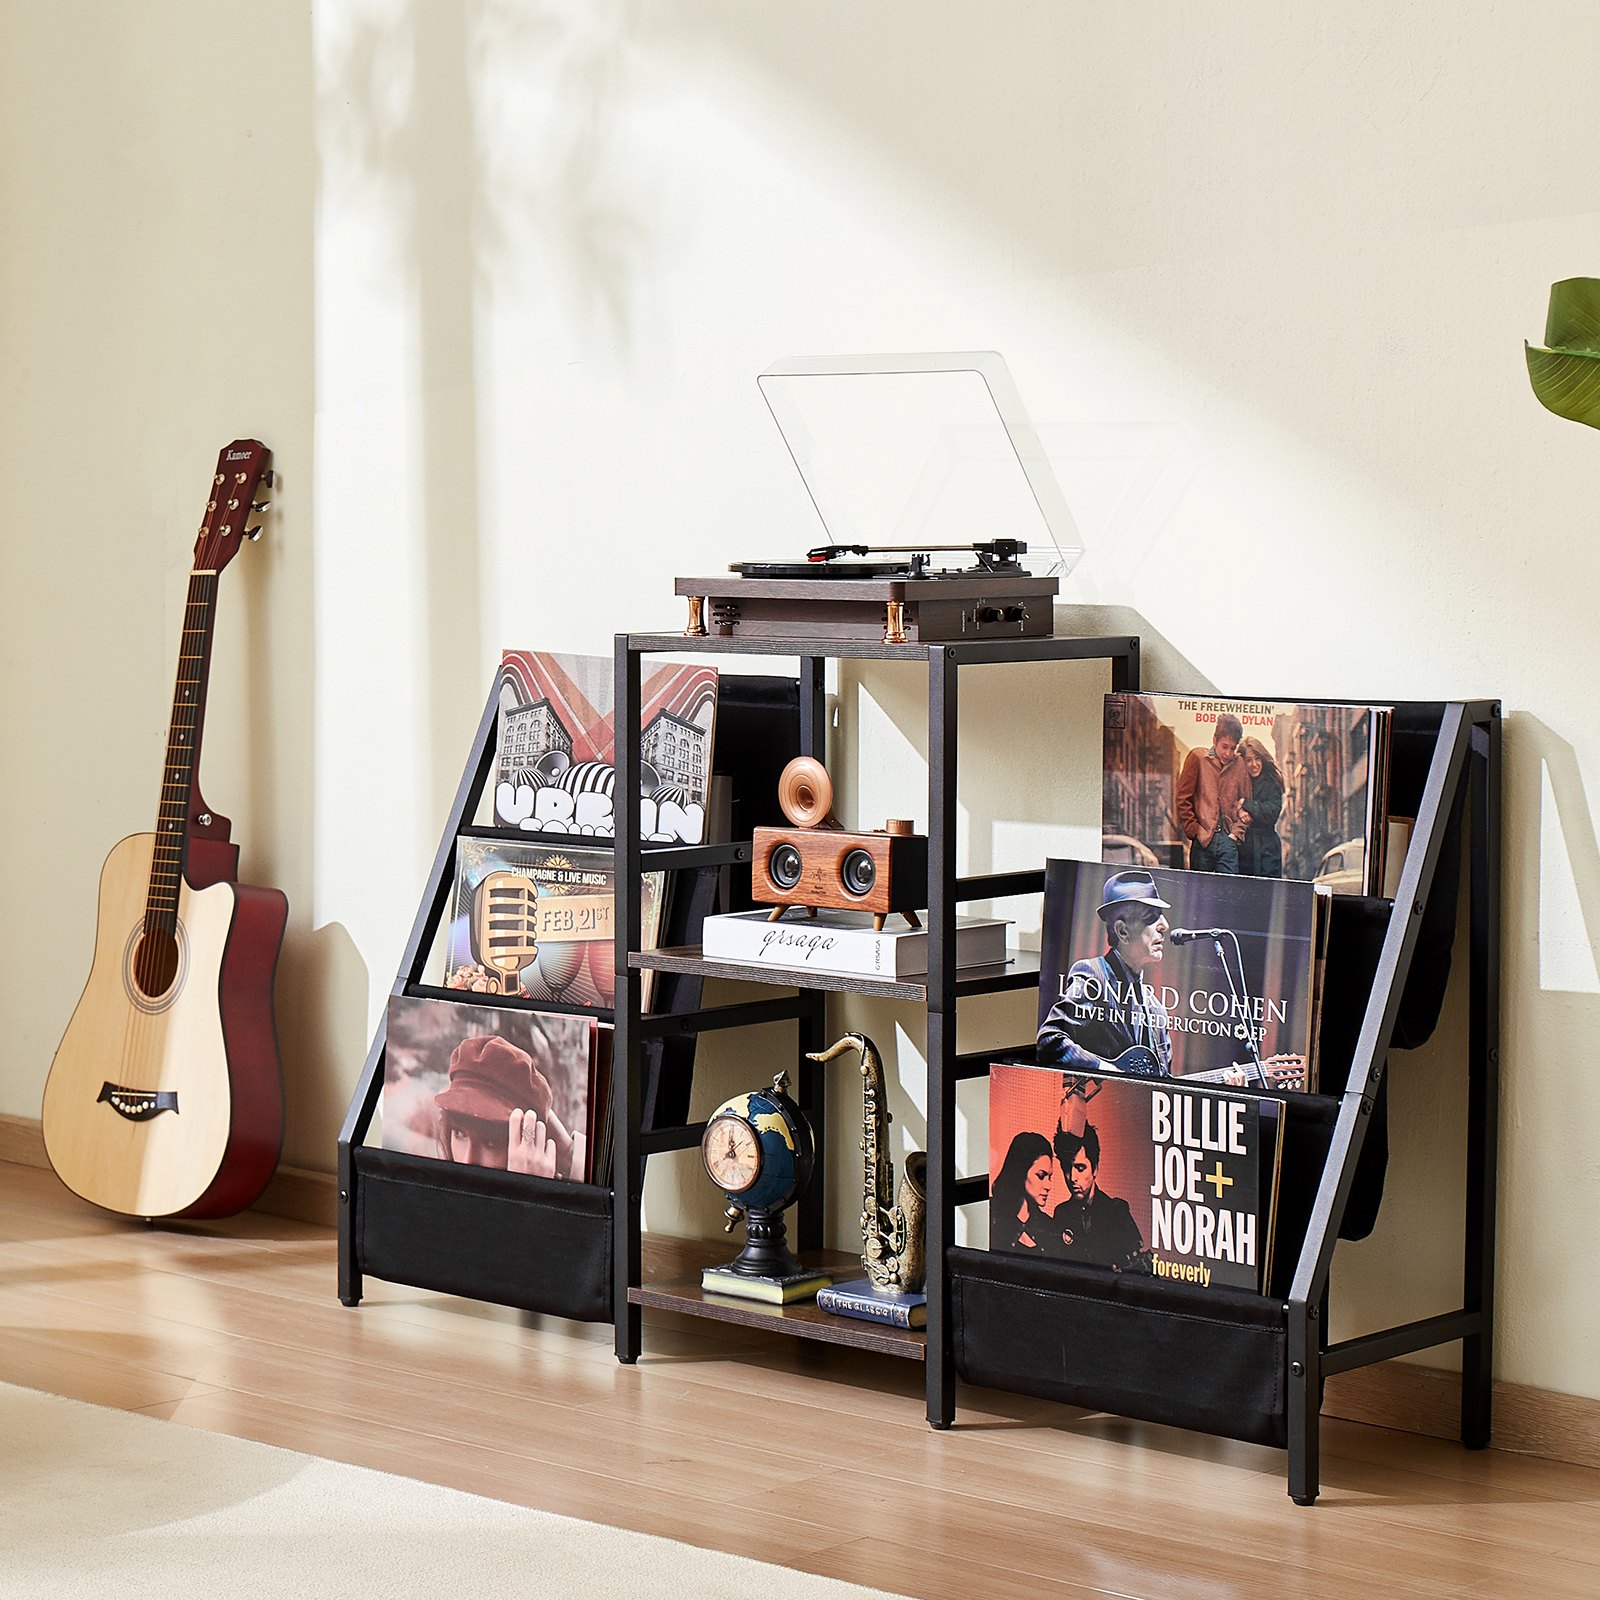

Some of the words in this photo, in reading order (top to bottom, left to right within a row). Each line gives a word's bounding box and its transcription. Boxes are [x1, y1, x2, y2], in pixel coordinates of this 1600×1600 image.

[1178, 700, 1198, 711] THE
[1200, 702, 1275, 714] FREEWHEELIN'
[1195, 713, 1217, 723] BOB
[1242, 715, 1274, 726] DYLAN
[511, 867, 556, 881] CHAMPAGNE
[557, 870, 564, 882] &
[565, 871, 581, 884] LIVE
[582, 873, 607, 885] MUSIC
[1059, 973, 1179, 1010] LEONARD
[1189, 990, 1288, 1024] COHEN
[1074, 1005, 1105, 1021] LIVE
[1109, 1009, 1126, 1024] IN
[1130, 1011, 1231, 1038] FREDERICTON
[1152, 1090, 1247, 1156] BILLIE
[1151, 1198, 1256, 1266] NORAH
[1152, 1253, 1211, 1288] foreverly
[836, 1299, 853, 1310] THE
